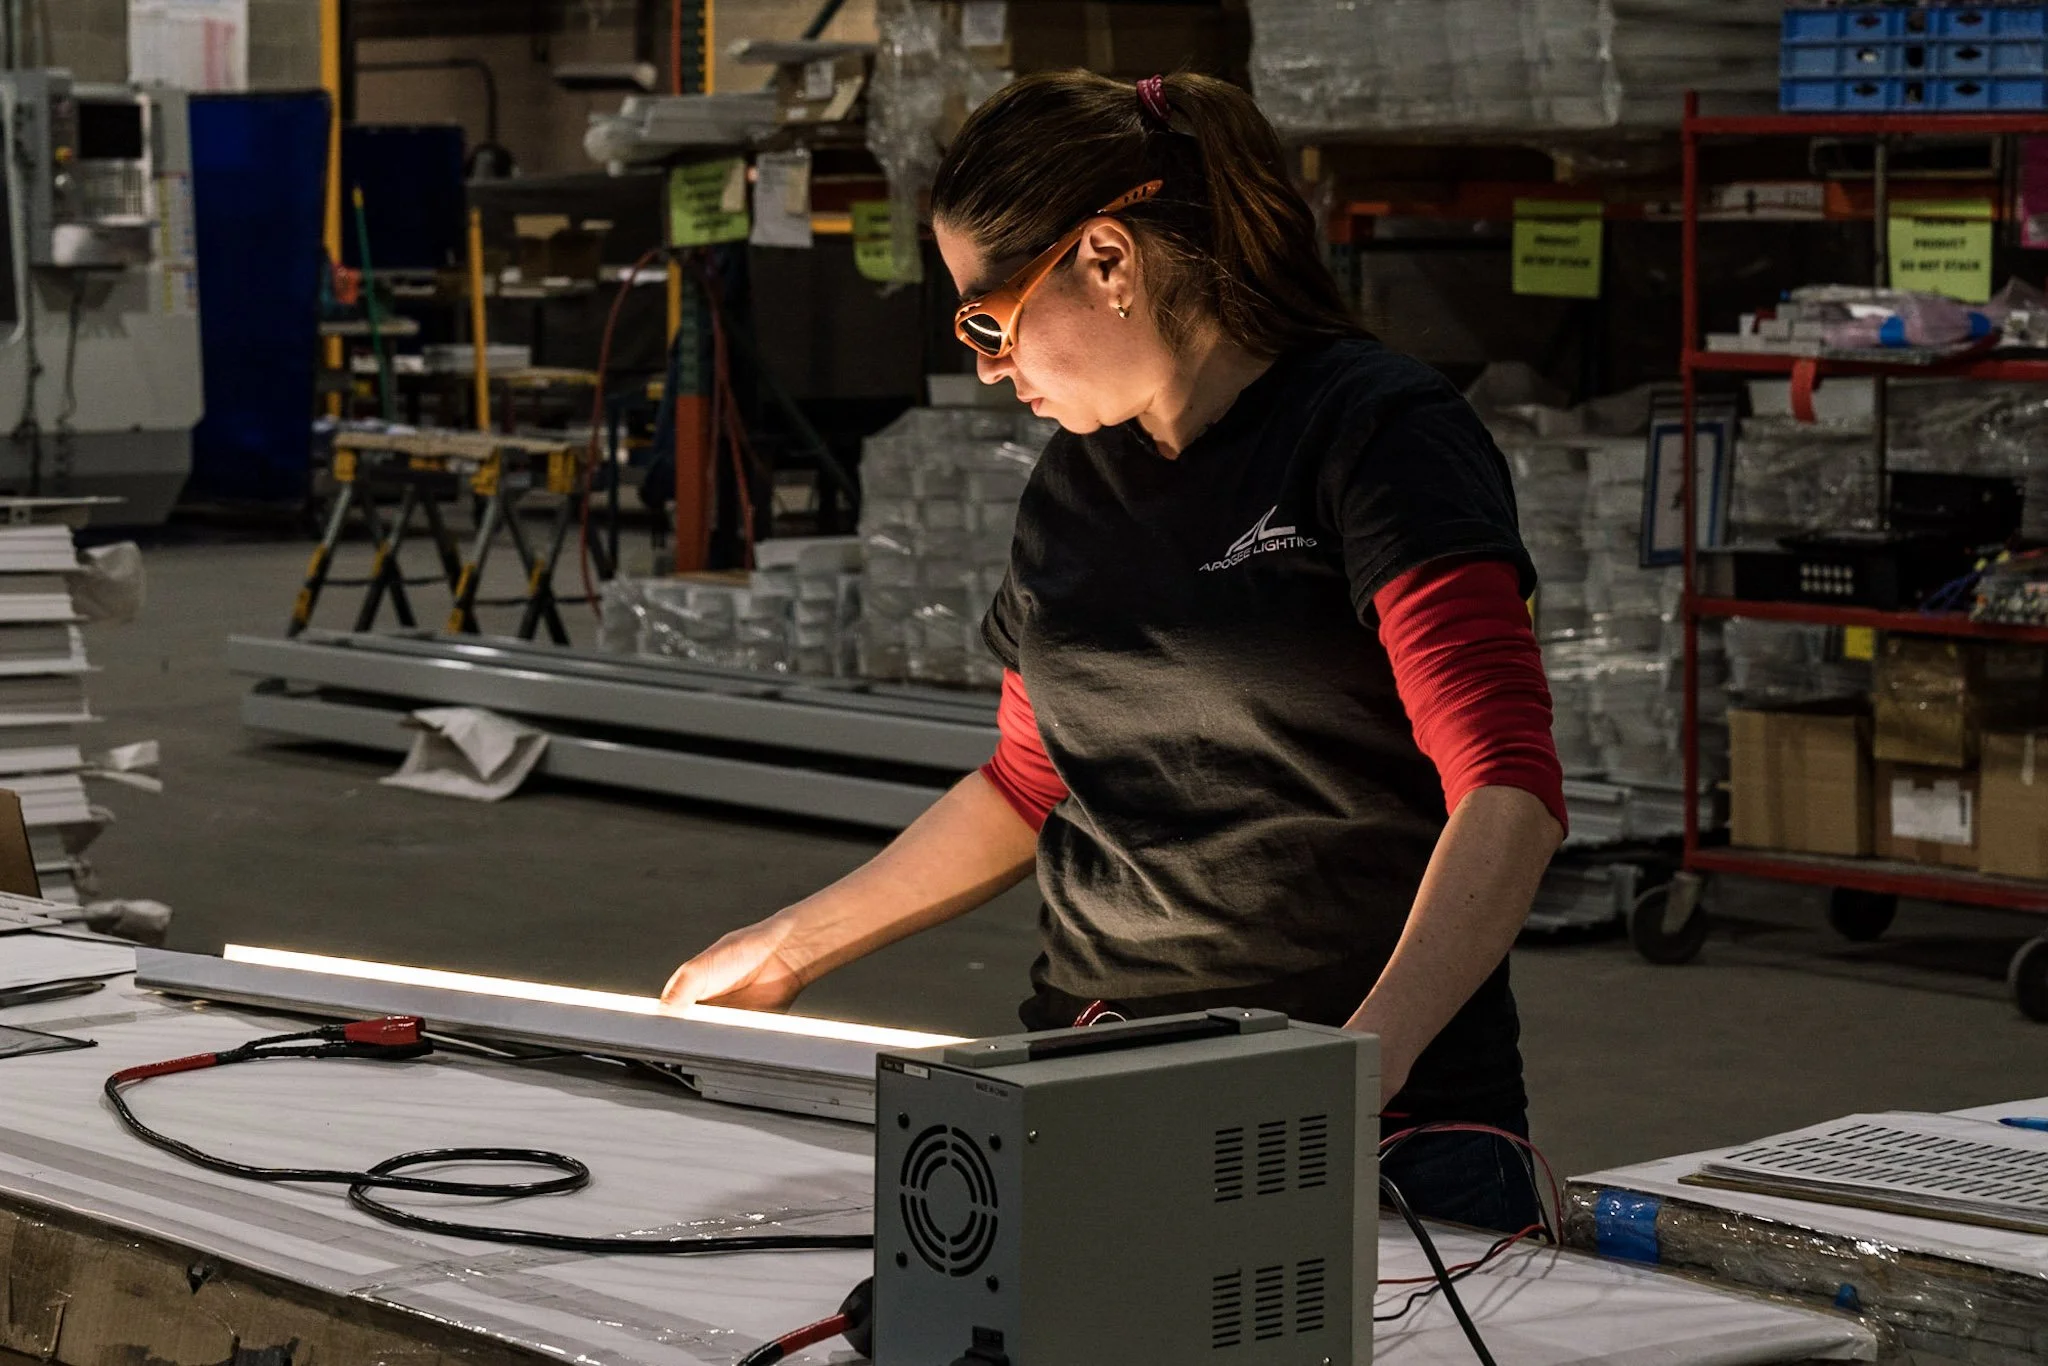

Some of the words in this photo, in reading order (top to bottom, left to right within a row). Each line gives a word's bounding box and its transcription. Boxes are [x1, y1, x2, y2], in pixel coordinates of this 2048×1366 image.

[1913, 237, 1966, 250] PRODUCT
[1900, 259, 1915, 272] DO
[1918, 259, 1940, 272] NOT
[1943, 259, 1981, 272] STACK
[1199, 547, 1252, 571] APOGEE
[1253, 536, 1318, 554] LIGHTING
